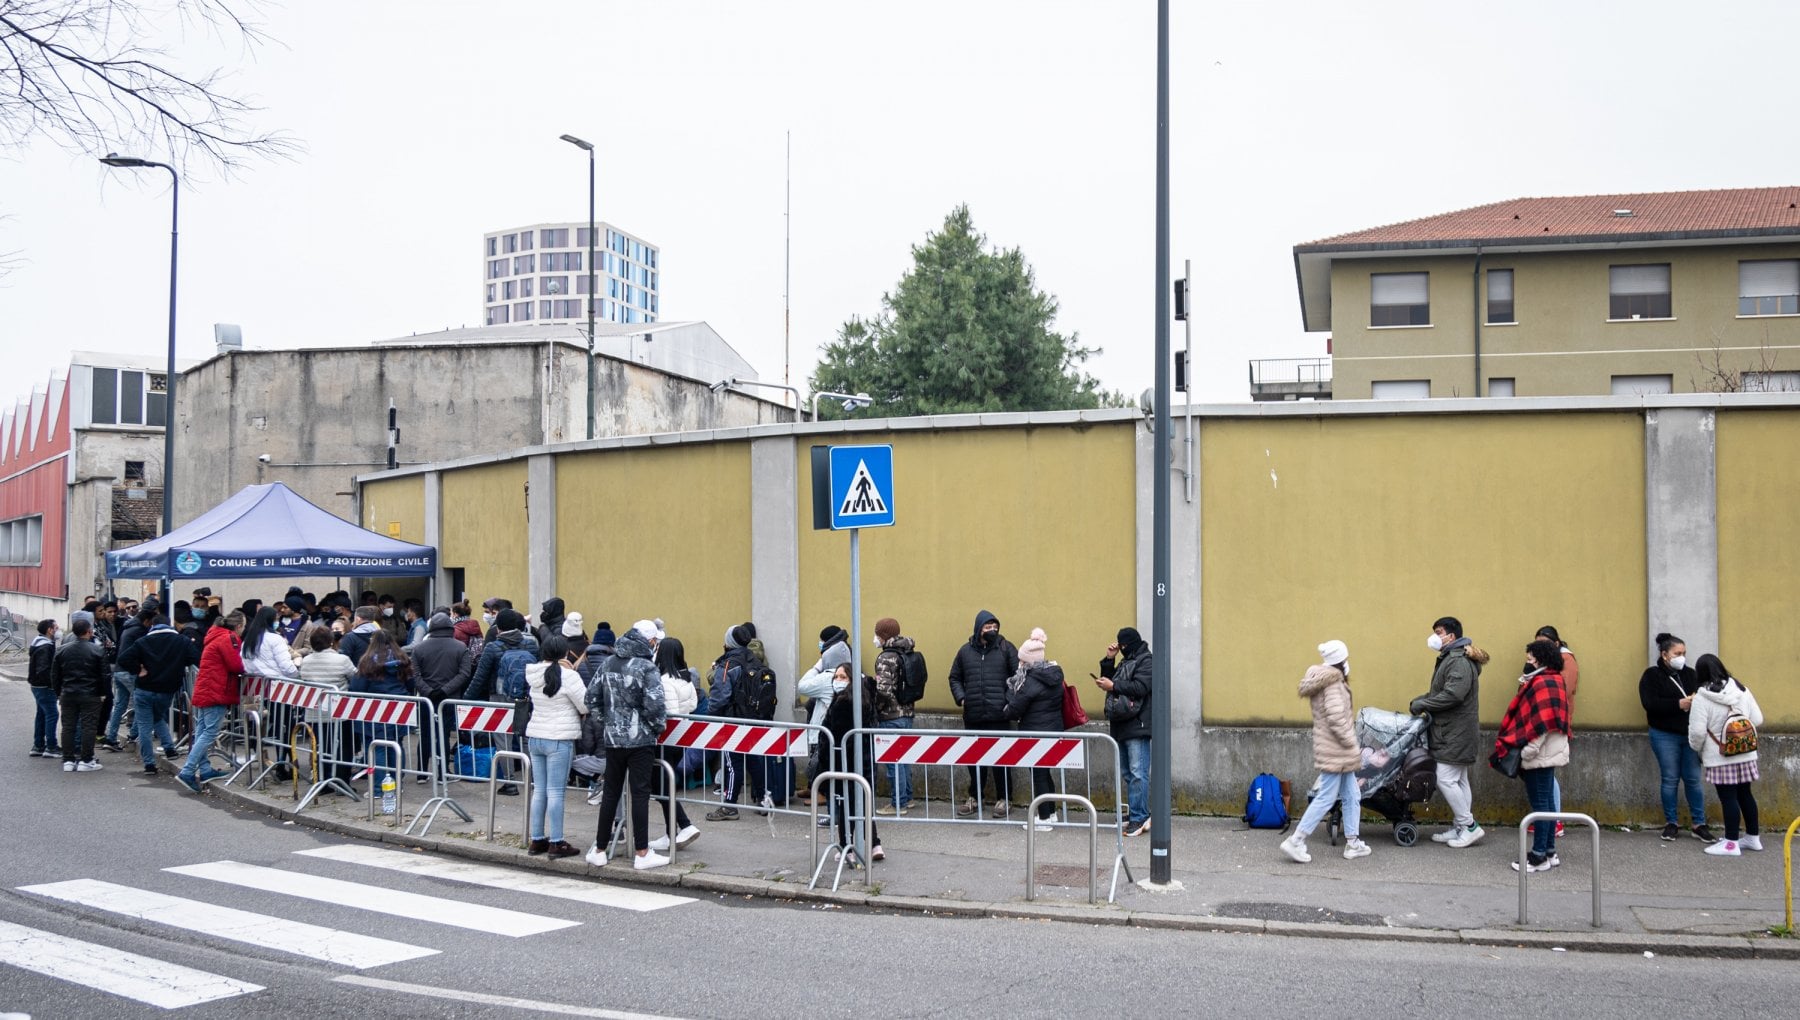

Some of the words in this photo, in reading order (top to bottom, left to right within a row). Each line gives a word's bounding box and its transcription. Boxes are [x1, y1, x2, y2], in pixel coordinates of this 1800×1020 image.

[209, 558, 257, 567] COMUNE
[263, 558, 275, 567] DI
[281, 556, 322, 566] MILANO
[327, 557, 392, 566] PROTEZIONE
[397, 557, 430, 566] CIVILE
[1157, 582, 1166, 597] 8
